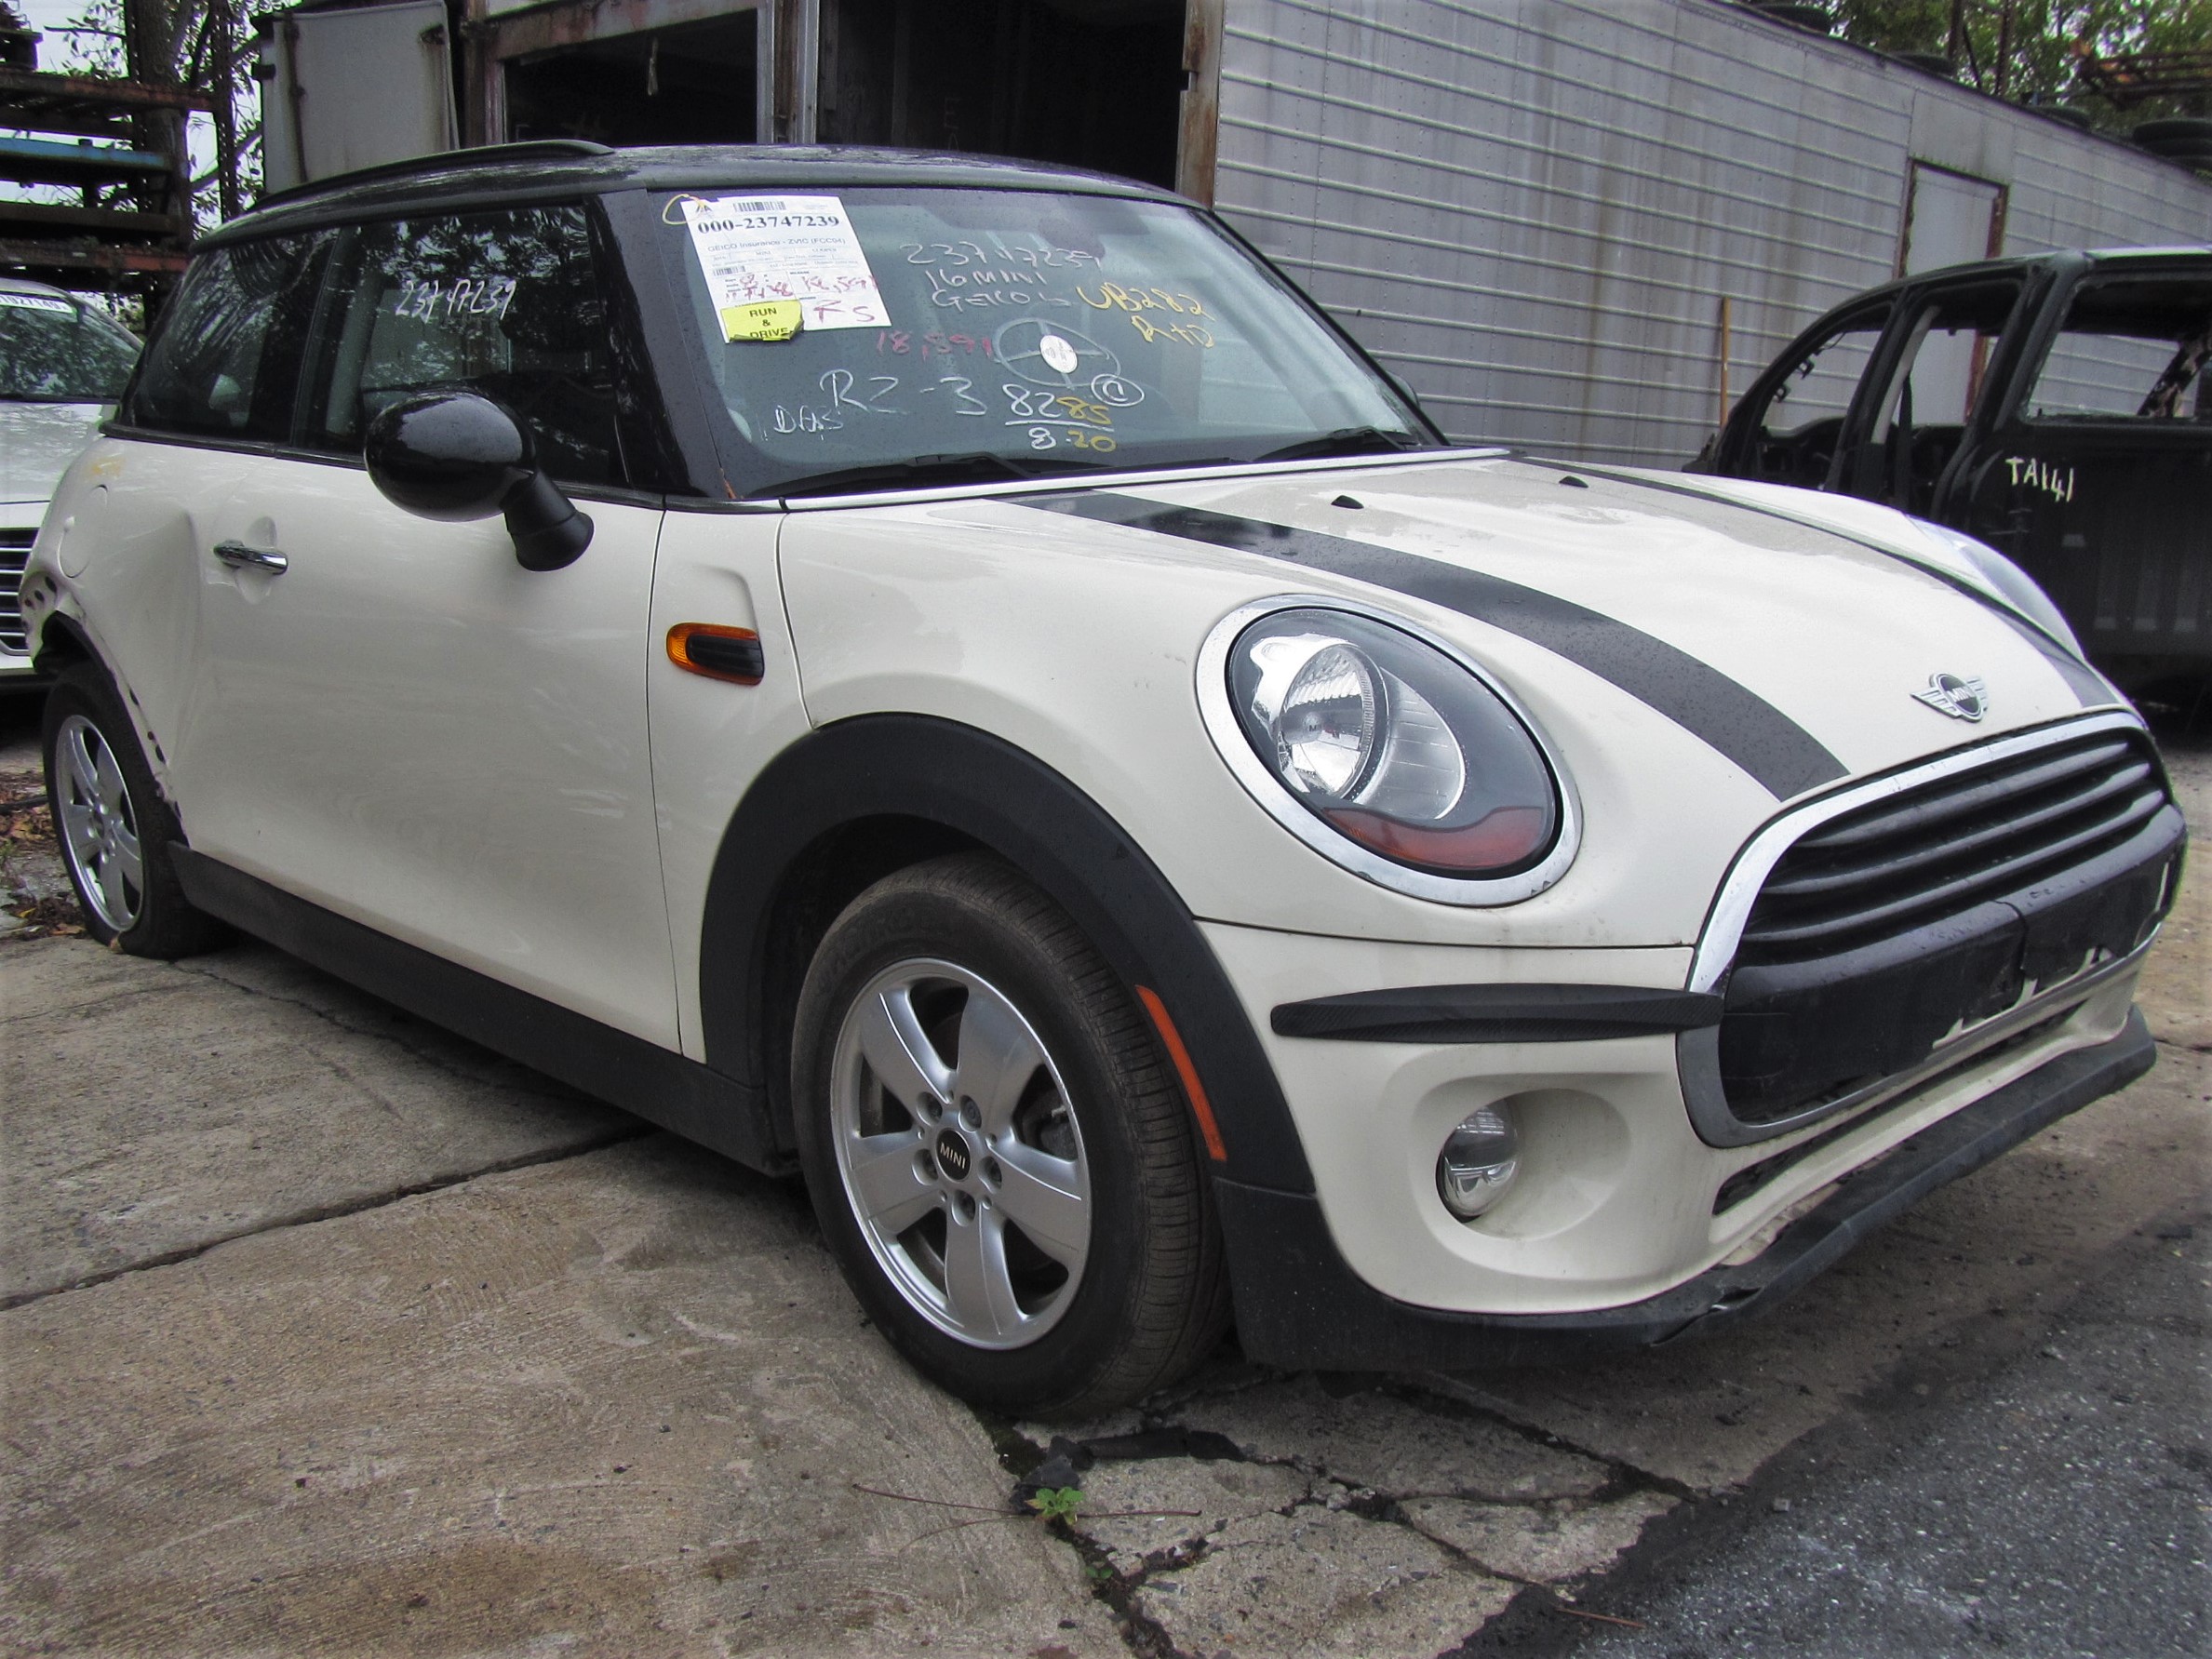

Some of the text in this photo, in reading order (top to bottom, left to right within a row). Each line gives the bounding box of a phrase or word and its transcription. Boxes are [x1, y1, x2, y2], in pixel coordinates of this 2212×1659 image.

[697, 215, 840, 234] 000-23747239
[707, 244, 738, 252] GEICO
[739, 240, 781, 248] Insurance
[972, 269, 1047, 286] MINI
[749, 307, 777, 317] RUN
[750, 328, 788, 338] DRIVE
[940, 1142, 966, 1170] MINI
